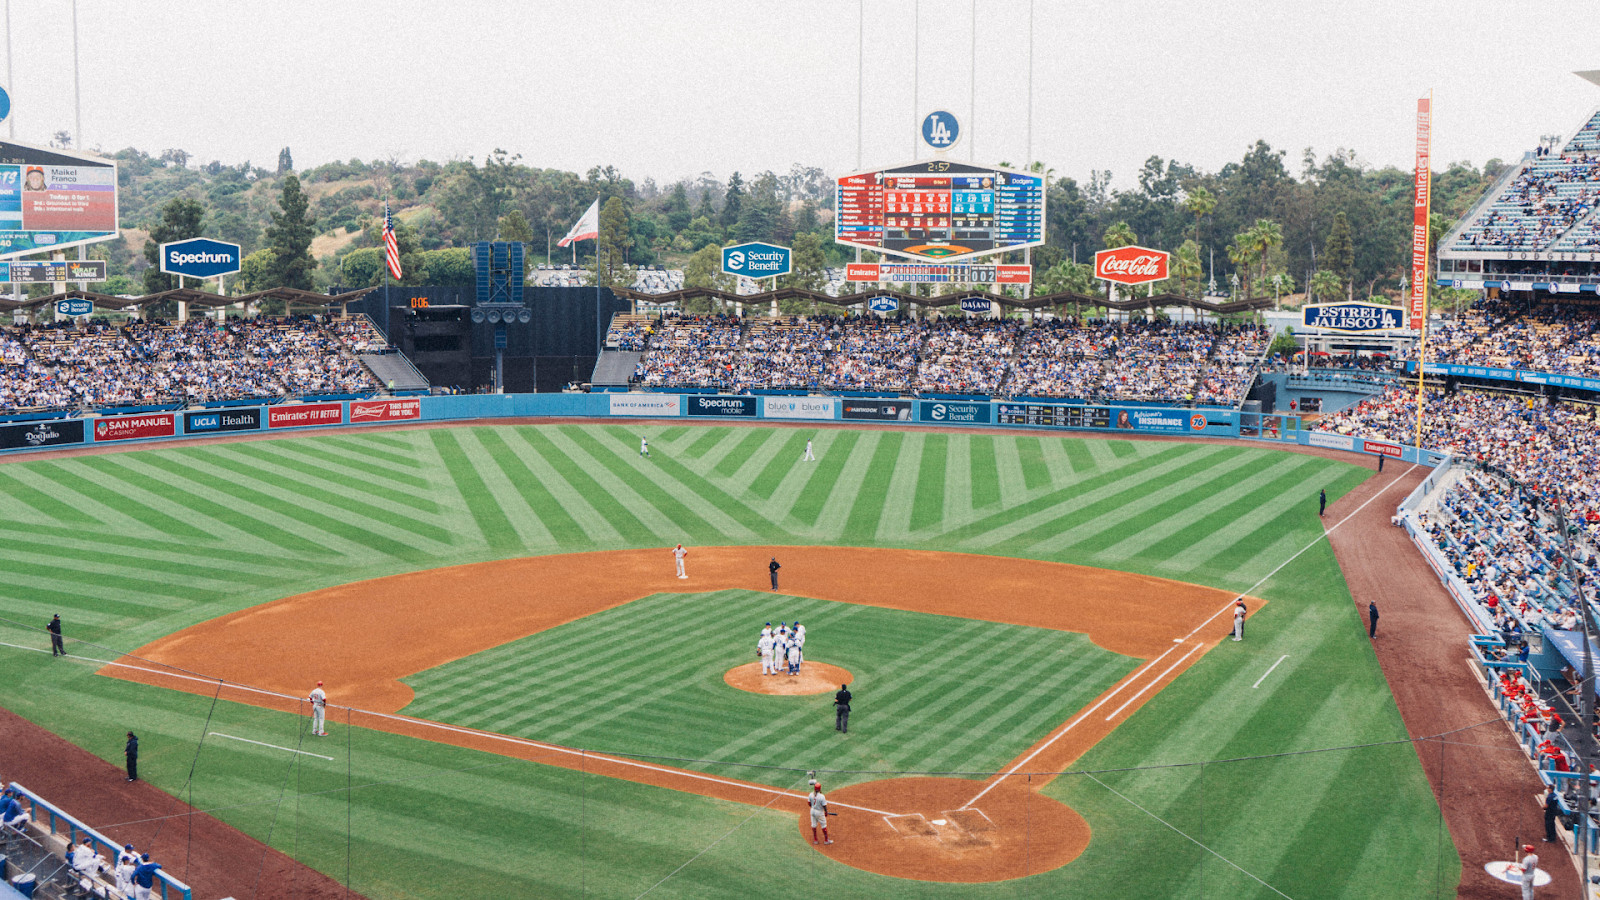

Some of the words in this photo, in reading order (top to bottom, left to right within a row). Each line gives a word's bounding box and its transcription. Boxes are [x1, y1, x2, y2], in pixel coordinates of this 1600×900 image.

[931, 115, 950, 144] LA
[928, 163, 950, 171] 2:57
[0, 171, 18, 184] TS
[1416, 157, 1427, 207] Emirates
[1414, 225, 1425, 251] BETTER
[170, 251, 230, 265] Spectrum
[748, 251, 784, 262] Security
[1413, 253, 1424, 265] FLY
[749, 261, 779, 270] Benefit
[1101, 255, 1162, 275] Coca-Cola
[972, 271, 978, 281] 0
[980, 271, 986, 281] 0
[989, 271, 994, 281] 2
[1412, 270, 1423, 319] Emirates
[411, 298, 428, 308] 0:06
[962, 300, 989, 309] DASANI
[1311, 317, 1377, 328] JALISCO
[699, 398, 742, 409] Spectrum
[949, 405, 978, 414] Security
[222, 415, 254, 425] Health
[271, 412, 307, 421] Emirates
[310, 411, 319, 419] FLY
[320, 410, 339, 418] BETTER
[109, 421, 129, 429] SAN
[131, 418, 171, 428] MANUEL
[1138, 418, 1183, 426] INSURANCE
[1192, 418, 1204, 427] 76
[25, 432, 42, 440] Don
